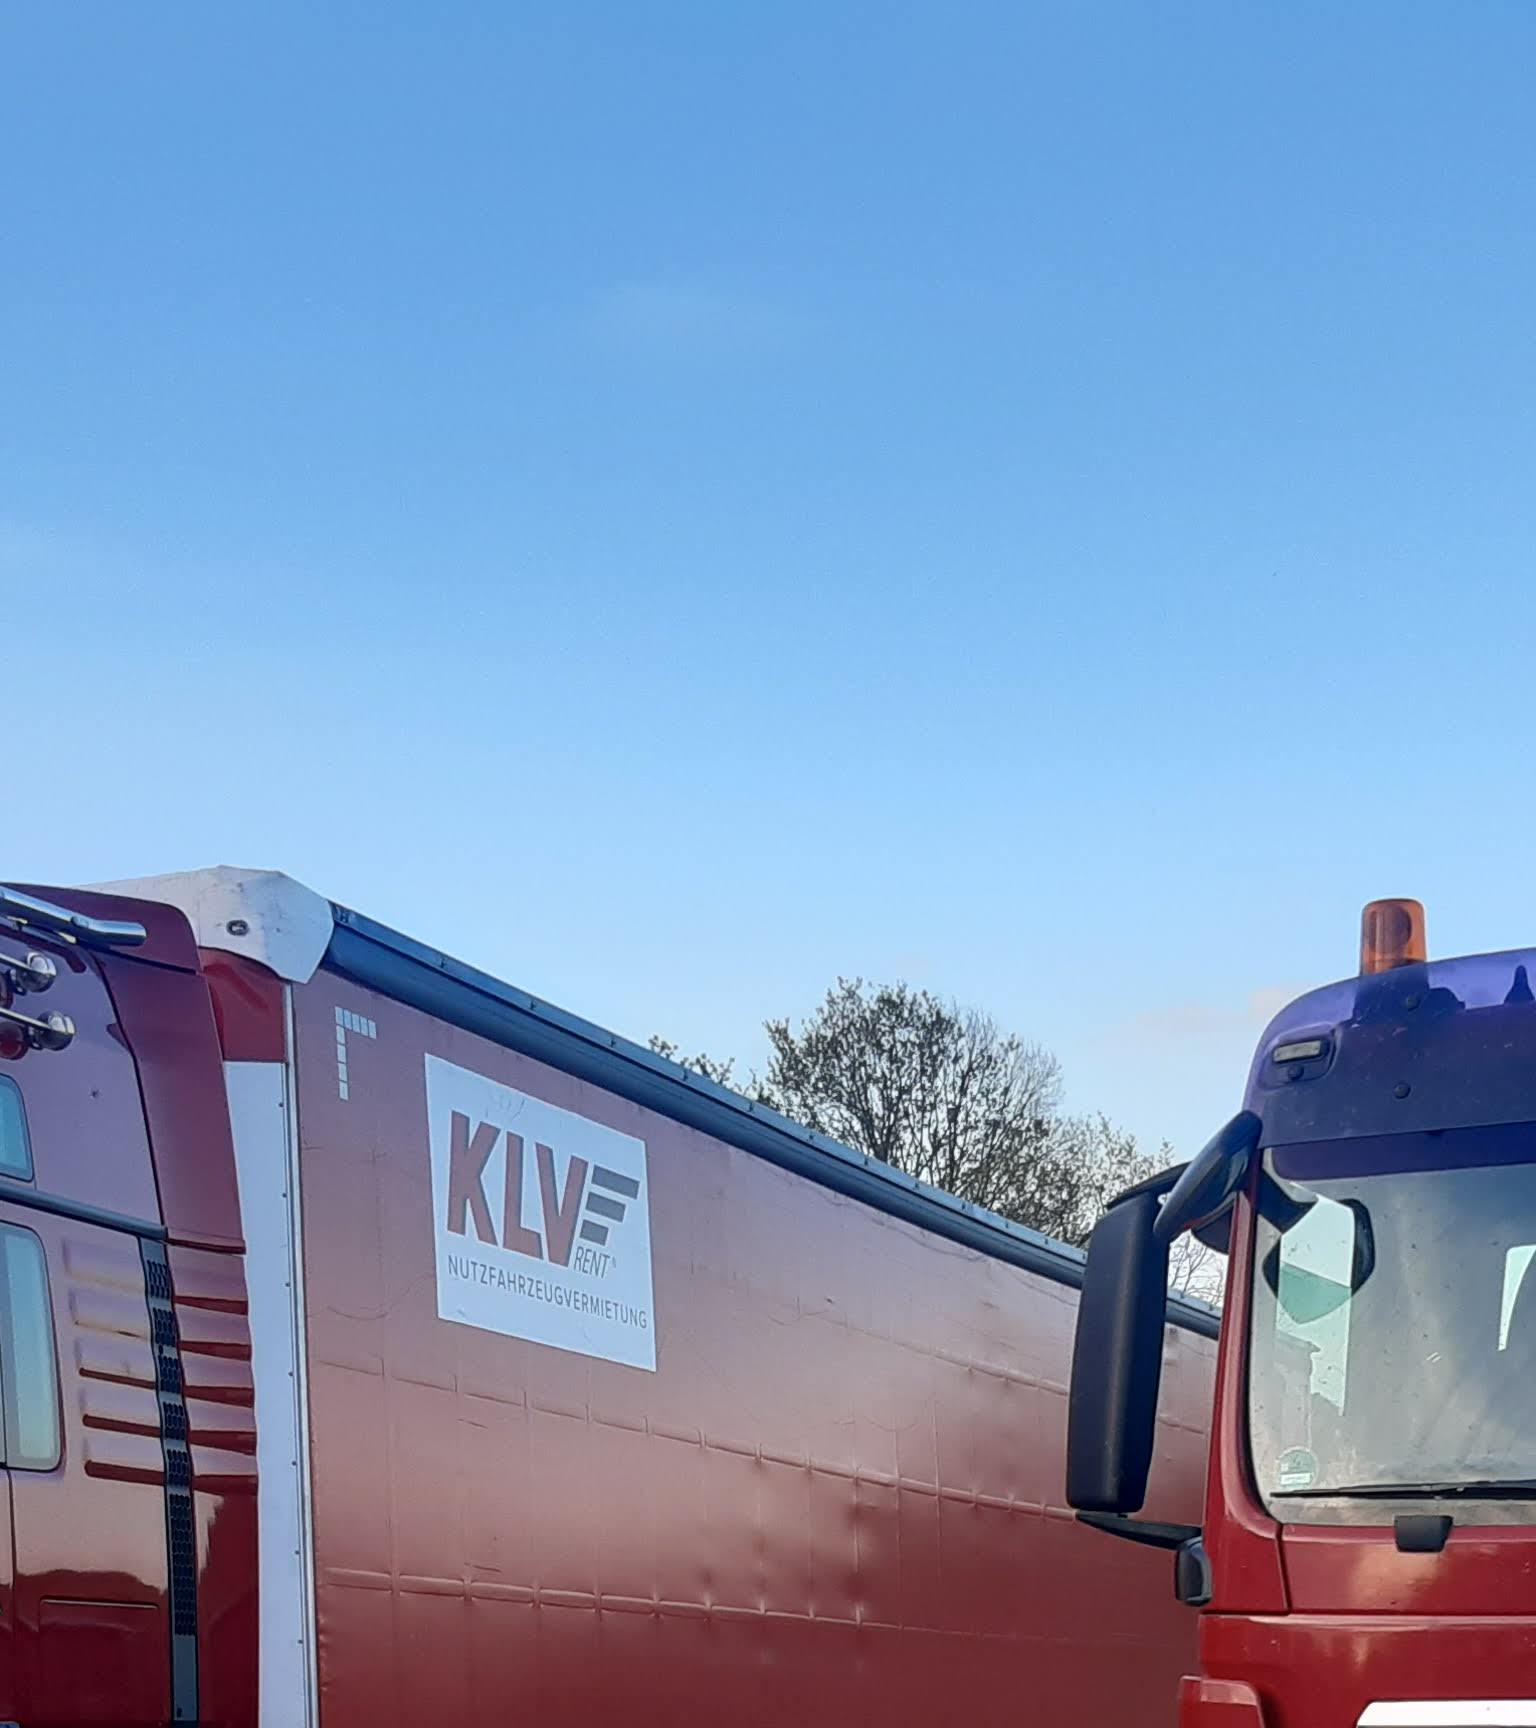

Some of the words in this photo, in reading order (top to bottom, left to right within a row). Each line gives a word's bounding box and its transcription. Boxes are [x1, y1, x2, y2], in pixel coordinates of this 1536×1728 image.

[447, 1110, 589, 1267] KLV
[448, 1255, 648, 1329] NUTZFAHRZEUGVERMIETUNG
[574, 1246, 610, 1279] RENT
